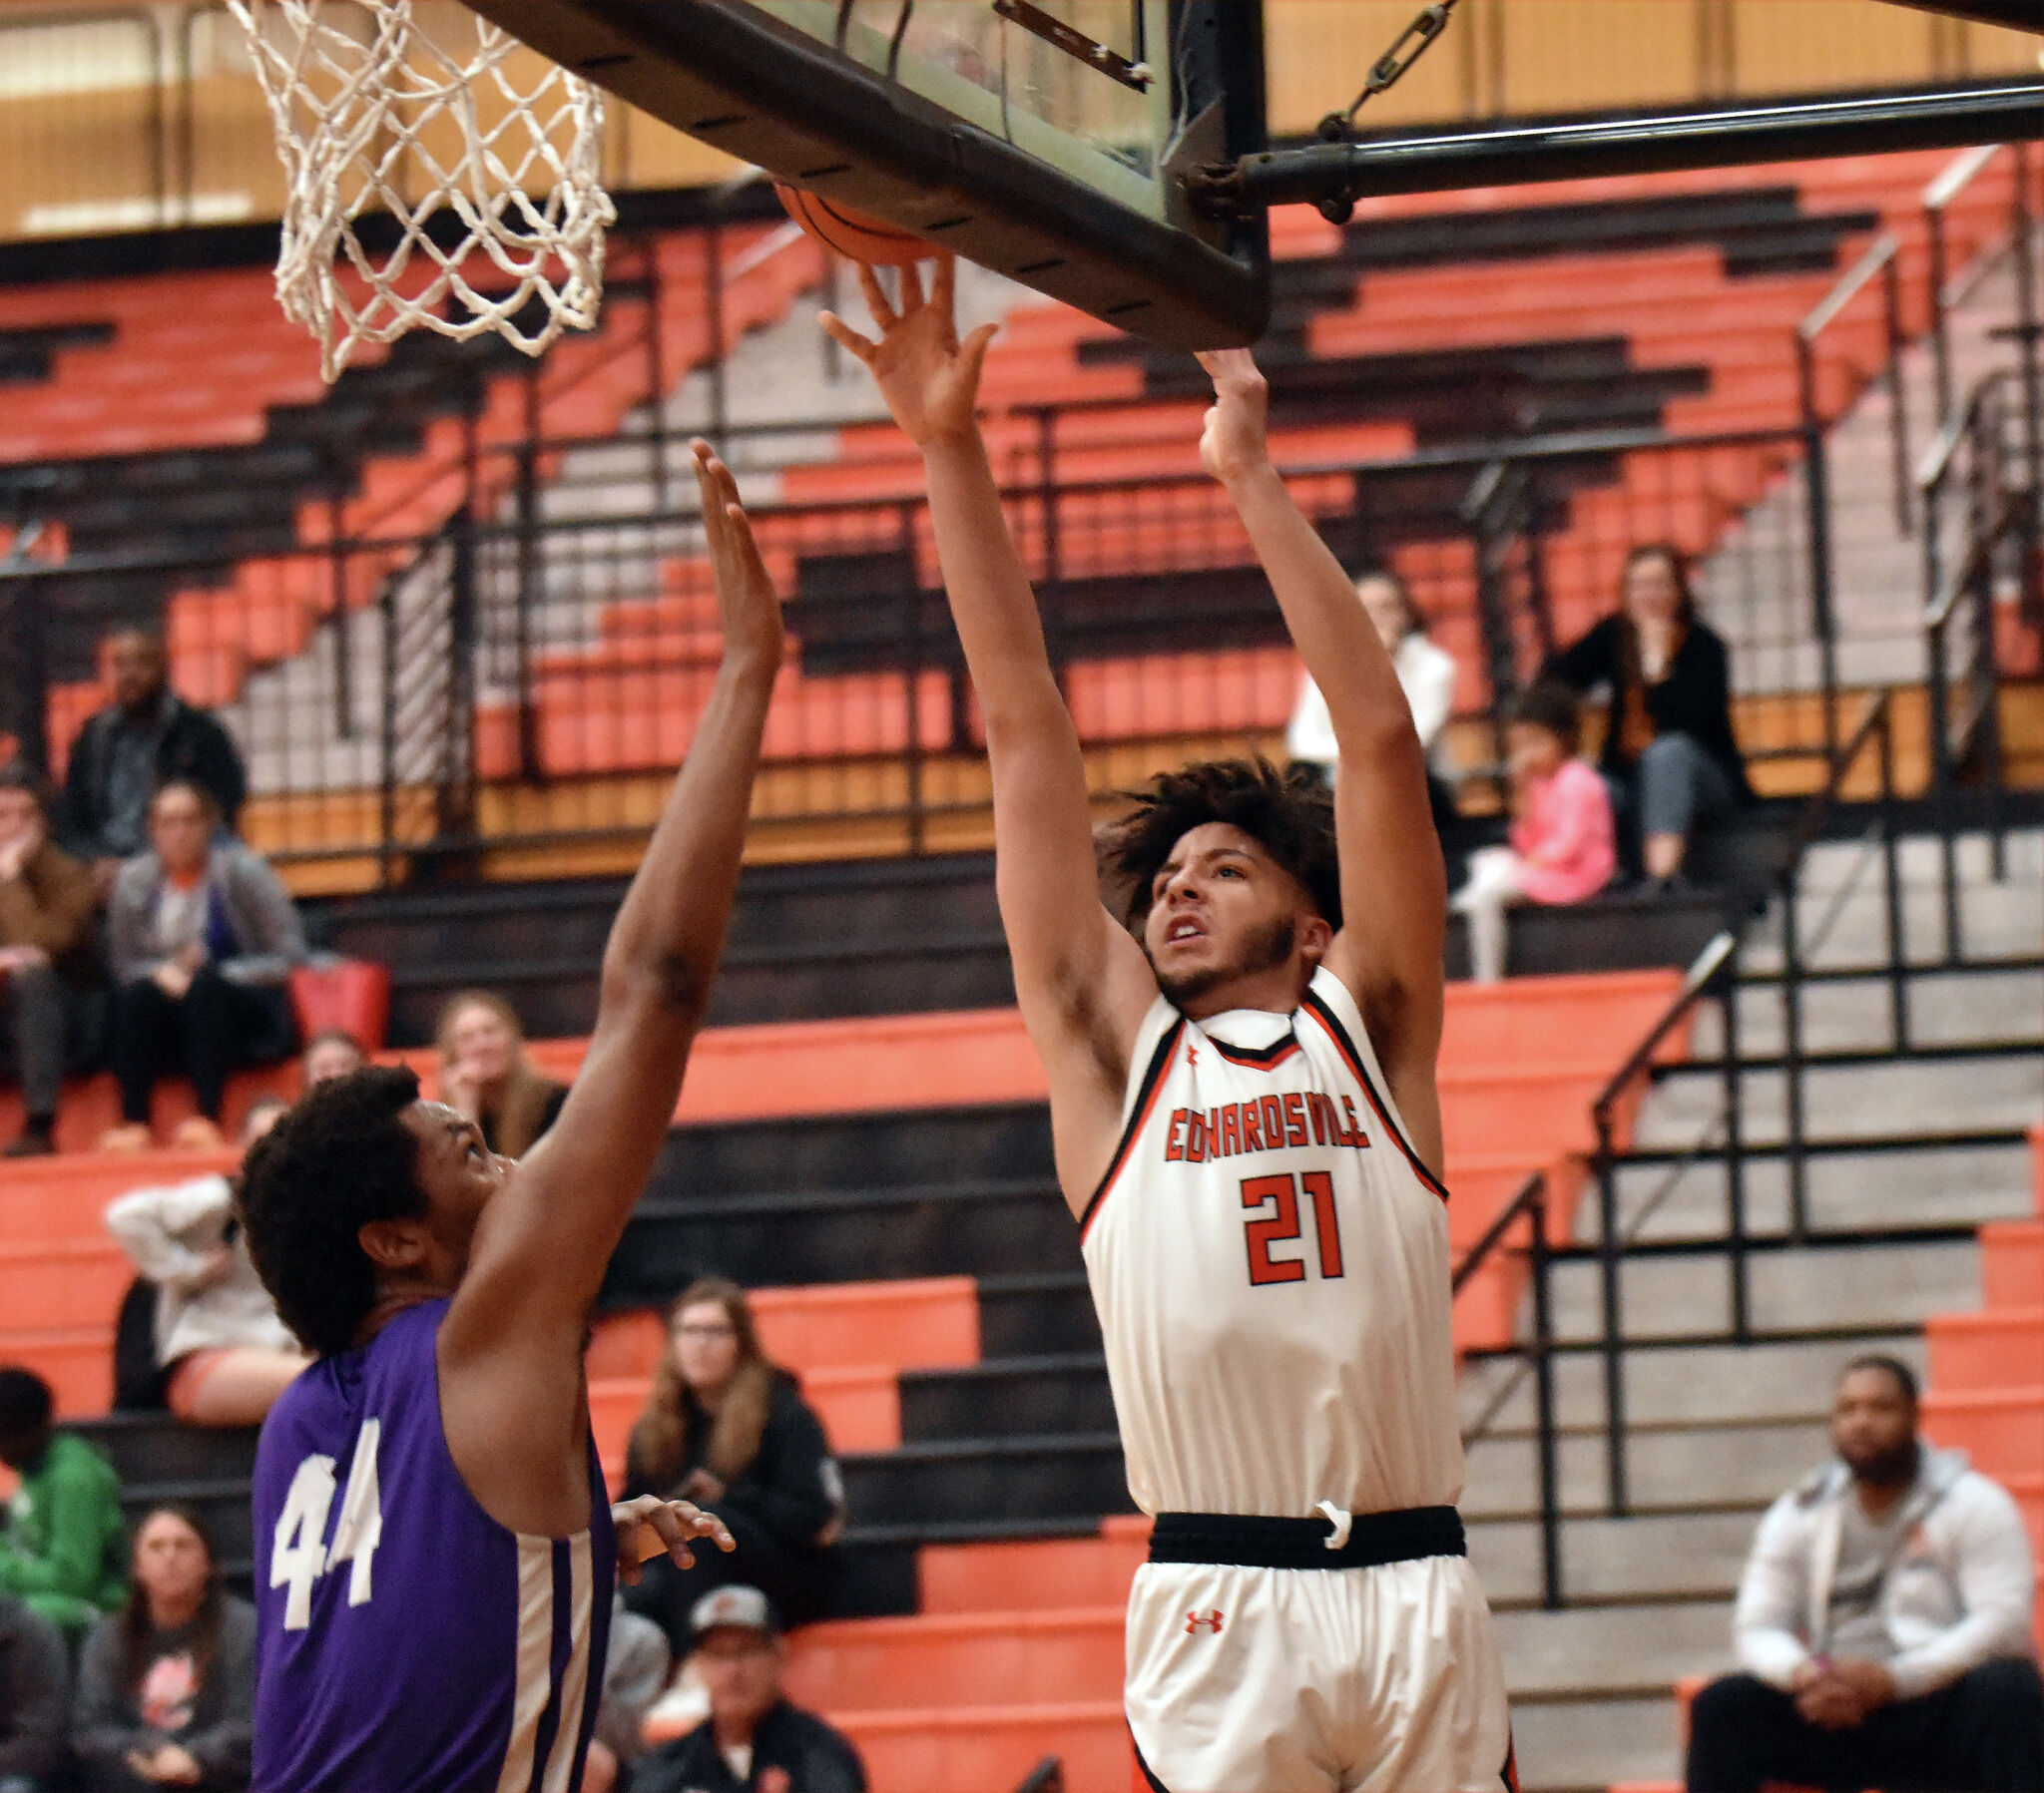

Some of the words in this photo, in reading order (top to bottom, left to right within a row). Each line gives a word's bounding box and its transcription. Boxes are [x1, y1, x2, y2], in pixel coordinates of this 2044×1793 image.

[1165, 1092, 1371, 1162] EDWARDSVILE
[1240, 1170, 1344, 1286] 21
[269, 1418, 383, 1630] 44
